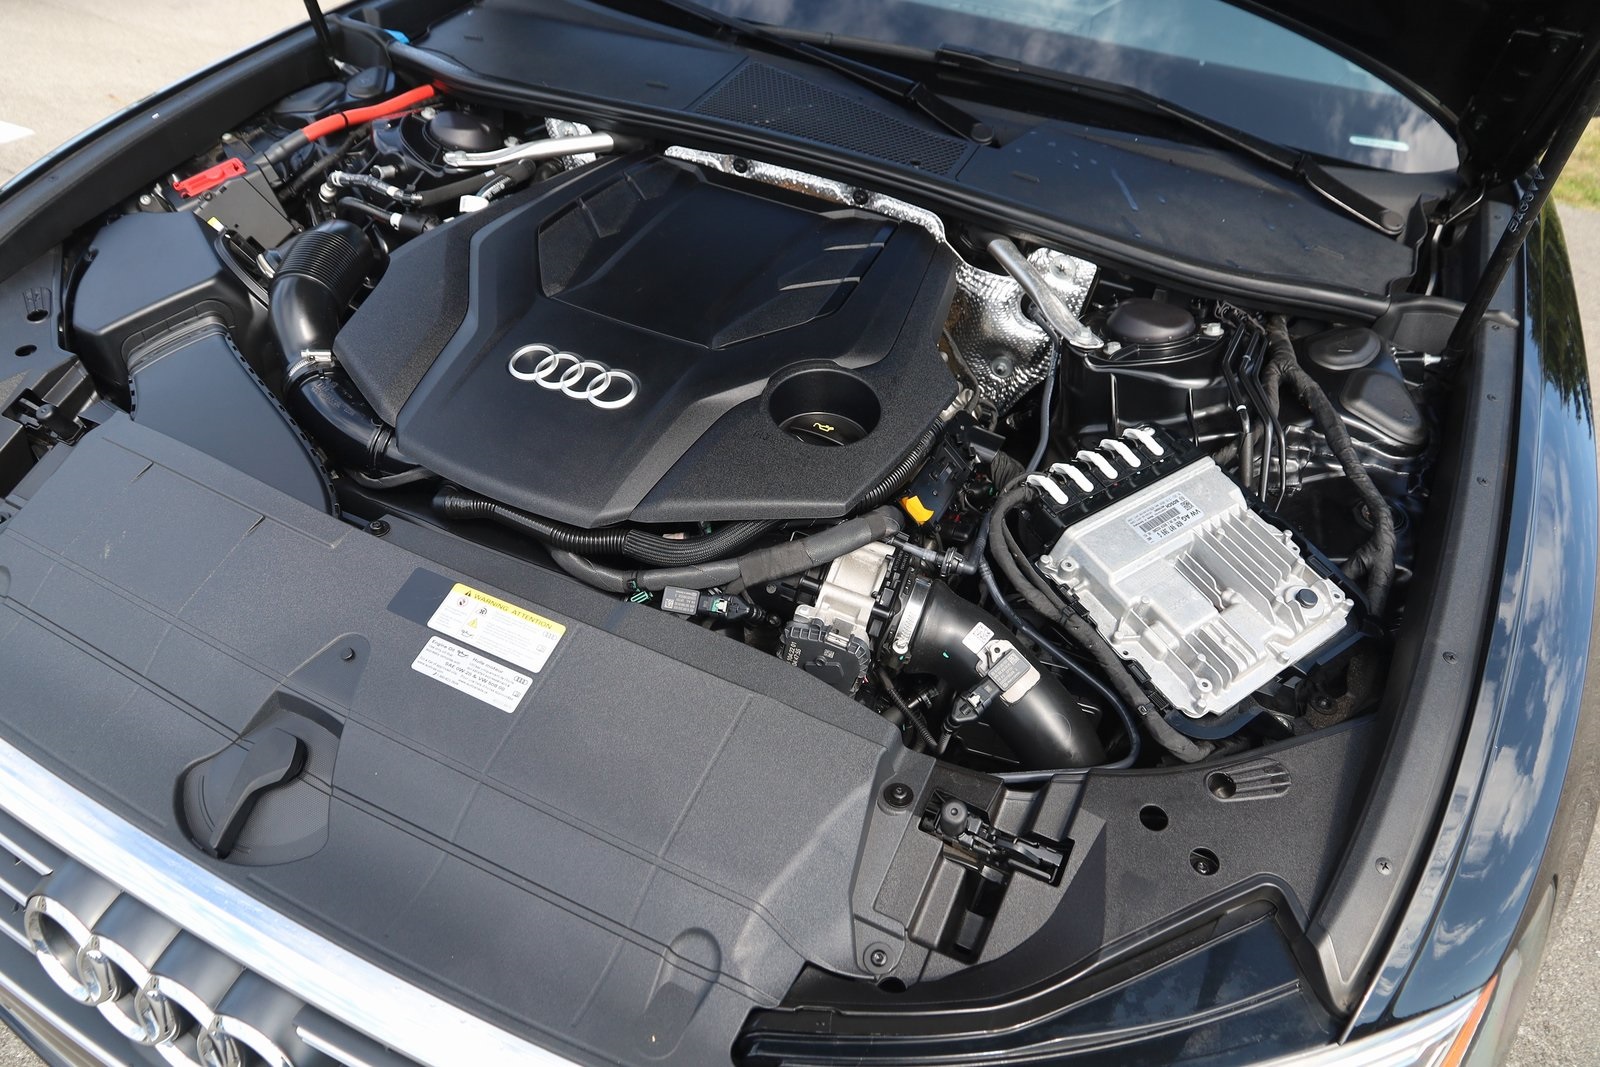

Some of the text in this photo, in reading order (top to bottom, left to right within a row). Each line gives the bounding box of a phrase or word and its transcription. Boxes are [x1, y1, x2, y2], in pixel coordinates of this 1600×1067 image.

[1165, 499, 1179, 508] BOSCH
[474, 594, 509, 611] WARNING
[511, 610, 553, 629] ATTENTION
[431, 640, 448, 649] Engine
